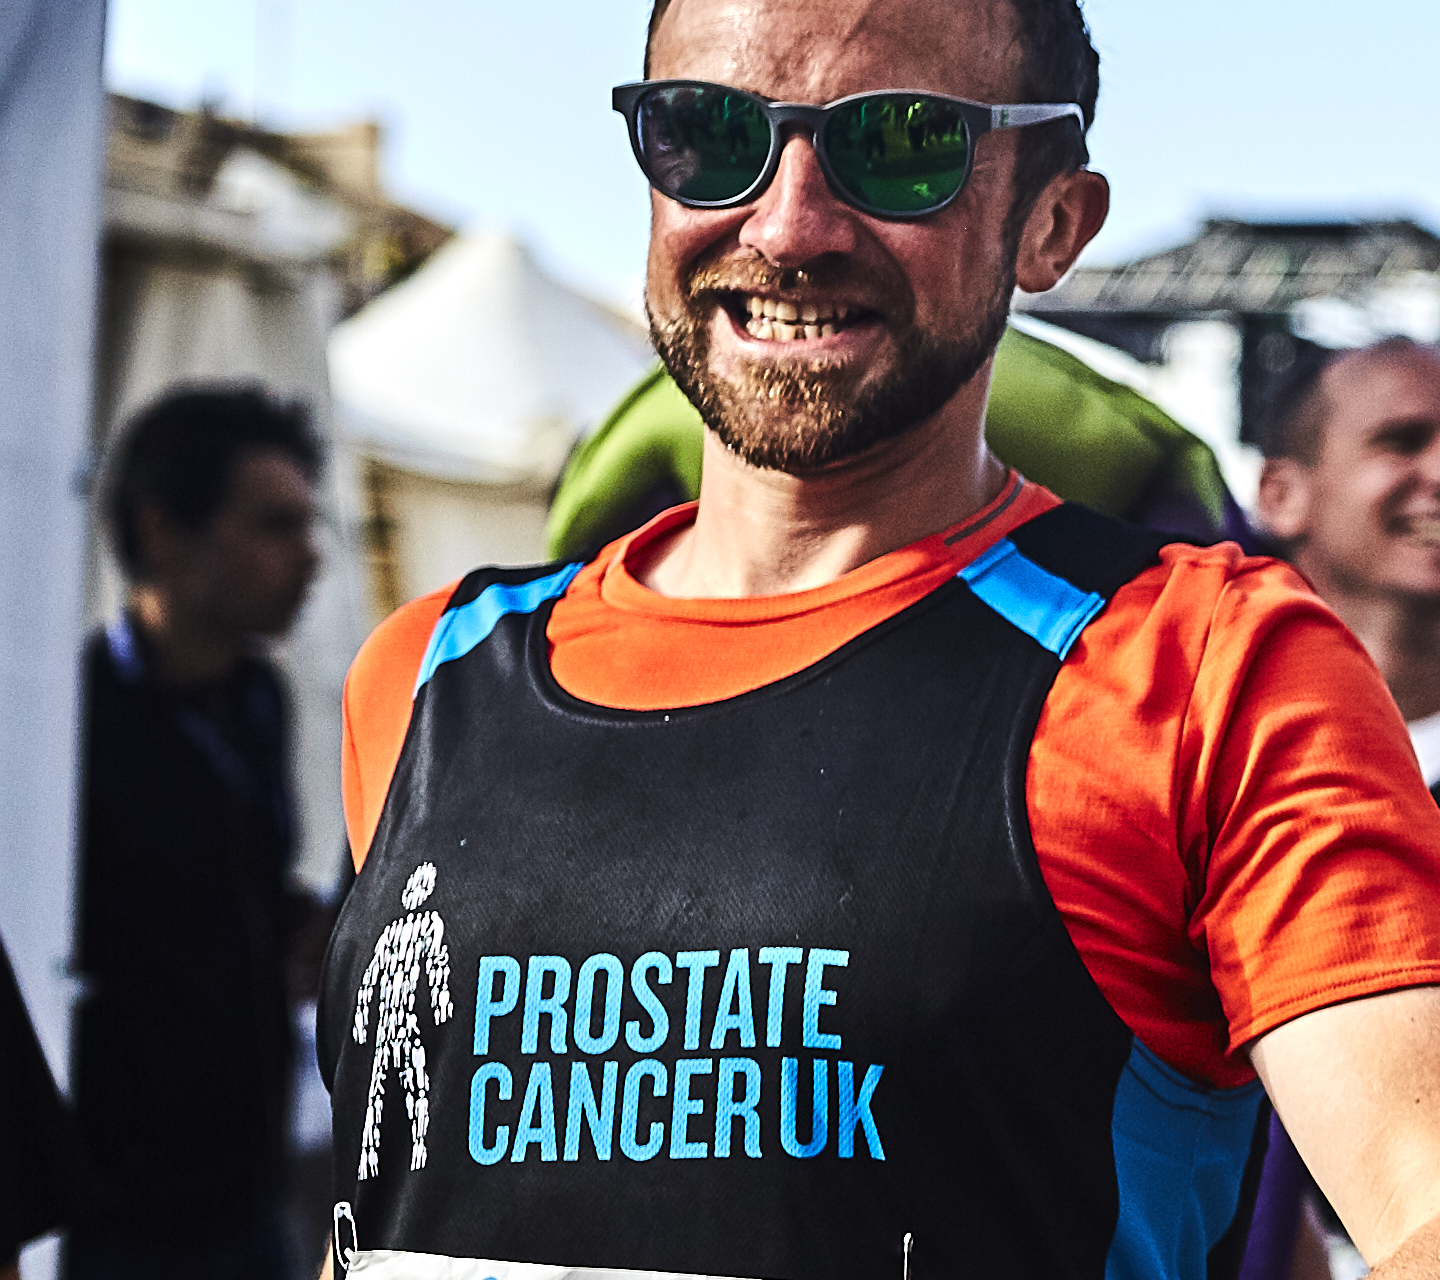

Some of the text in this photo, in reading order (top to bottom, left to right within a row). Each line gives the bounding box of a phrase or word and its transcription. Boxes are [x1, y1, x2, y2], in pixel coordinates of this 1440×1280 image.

[473, 946, 849, 1056] PROSTATE
[468, 1057, 886, 1165] CANCER UK
